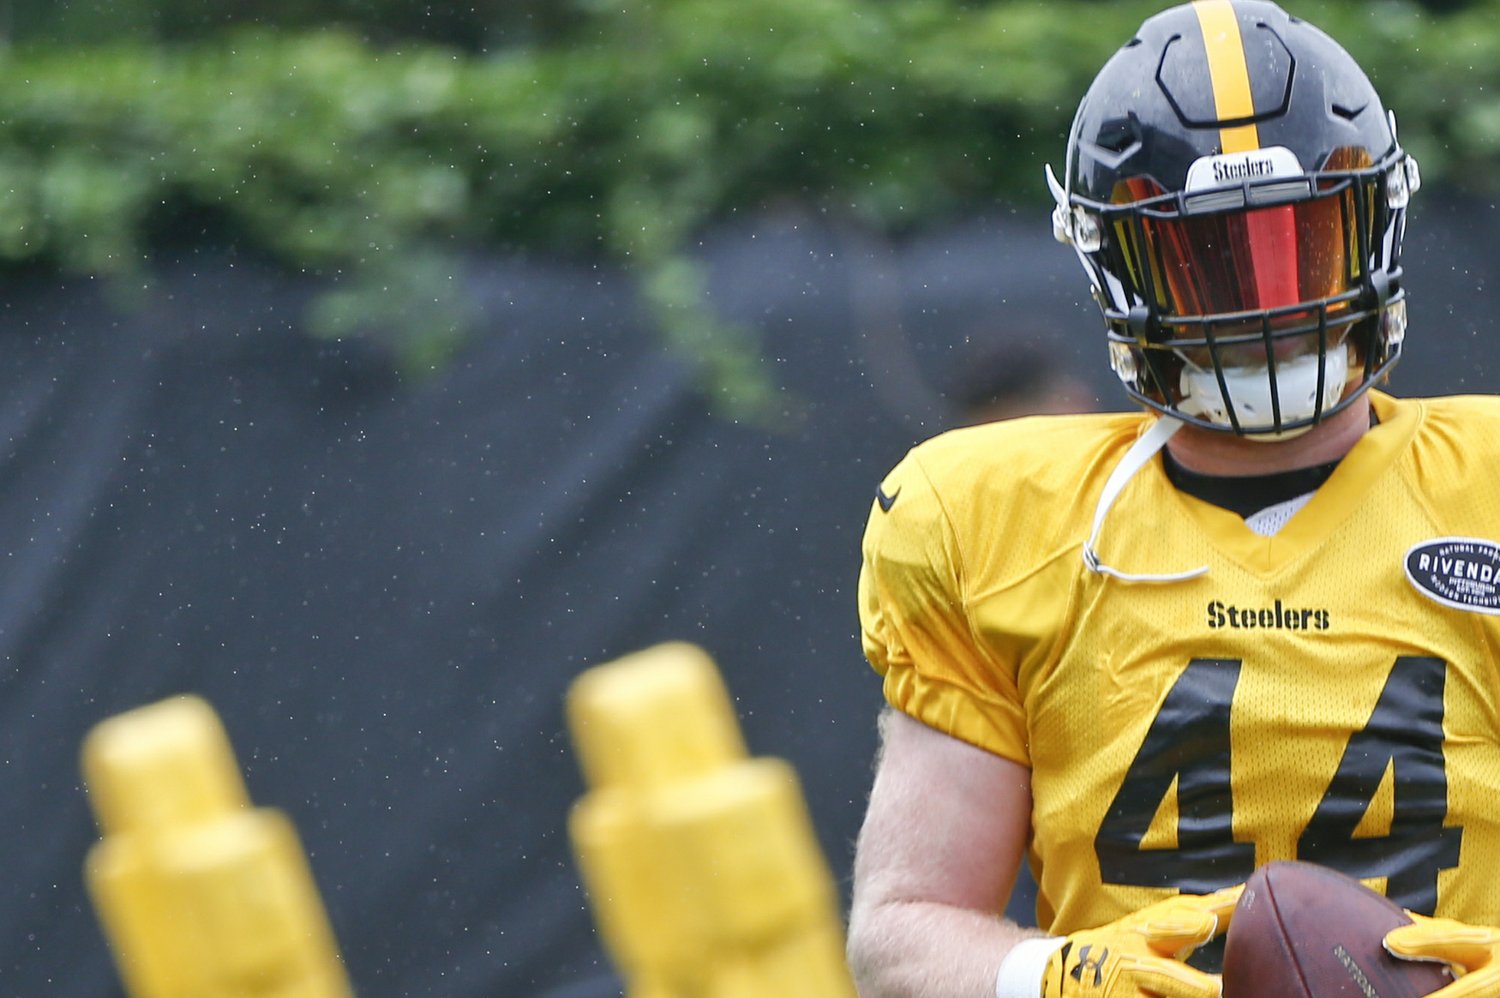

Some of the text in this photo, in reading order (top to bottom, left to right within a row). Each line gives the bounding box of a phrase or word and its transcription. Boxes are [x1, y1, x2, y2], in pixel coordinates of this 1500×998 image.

[1213, 156, 1274, 181] Steelers
[1207, 598, 1330, 631] Steelers
[1095, 656, 1464, 918] 44
